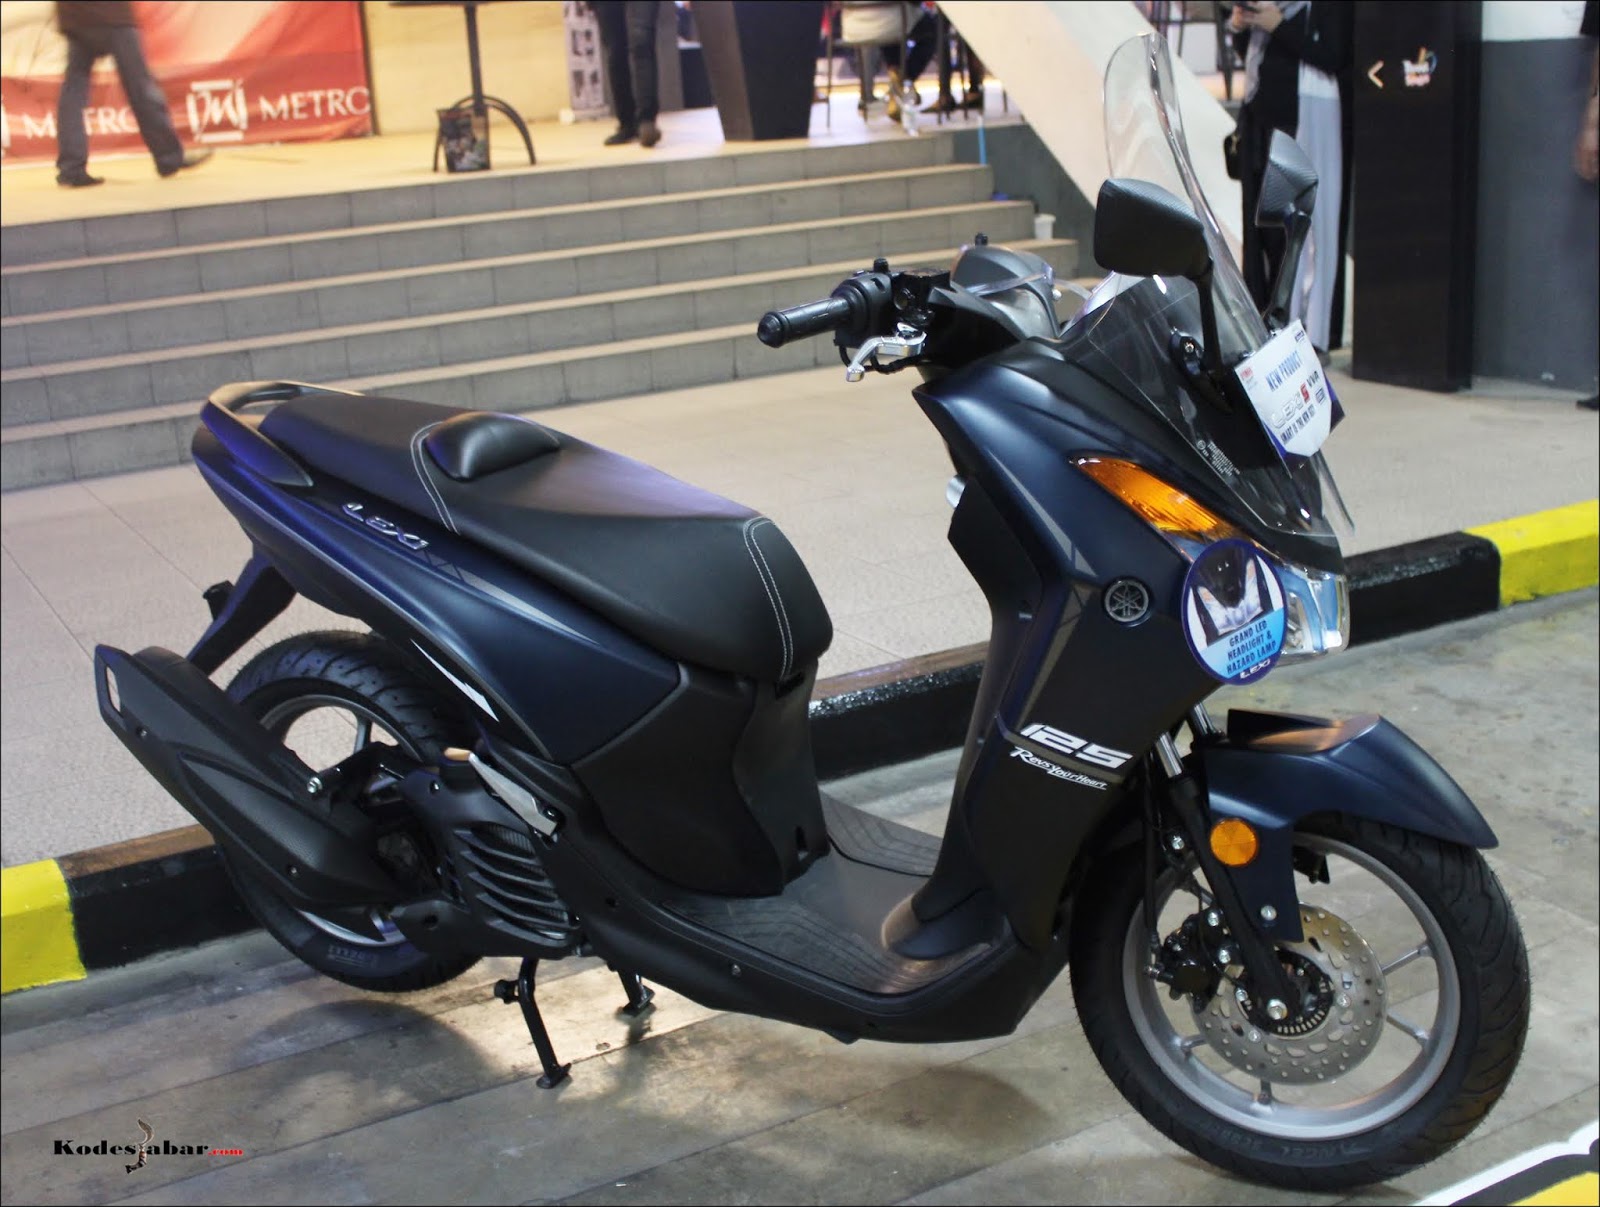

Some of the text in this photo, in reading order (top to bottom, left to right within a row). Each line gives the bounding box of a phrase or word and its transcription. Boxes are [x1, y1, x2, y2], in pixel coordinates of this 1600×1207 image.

[260, 86, 371, 121] METRO
[23, 106, 140, 138] MTRO
[1265, 369, 1283, 392] NEW
[1279, 350, 1303, 380] PRODUCT
[1227, 632, 1273, 661] HEADLIGHT &
[1229, 620, 1268, 647] GRAND LED
[1226, 641, 1277, 675] HAZARD LAMP
[1020, 723, 1134, 769] 125
